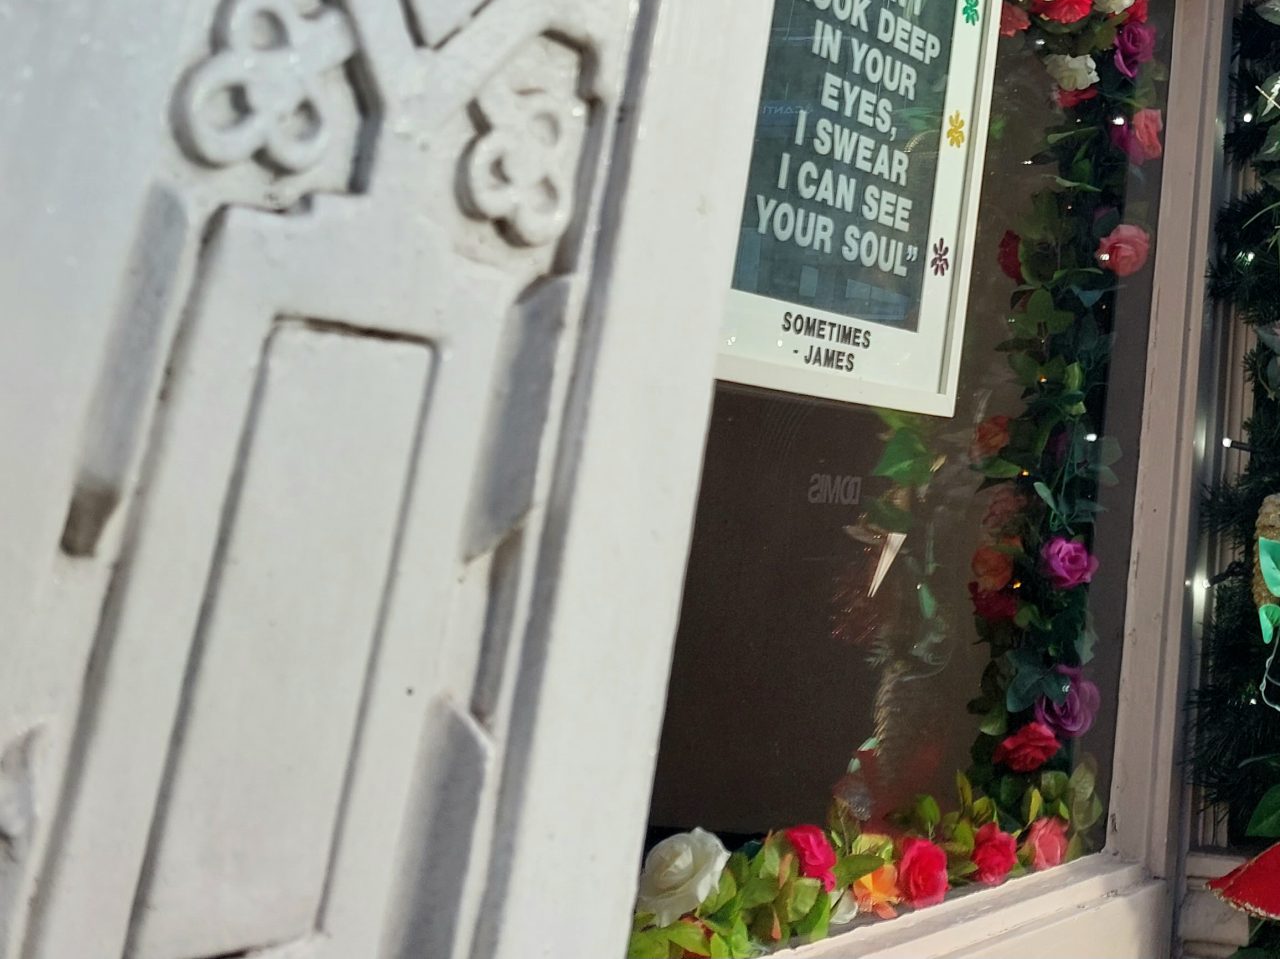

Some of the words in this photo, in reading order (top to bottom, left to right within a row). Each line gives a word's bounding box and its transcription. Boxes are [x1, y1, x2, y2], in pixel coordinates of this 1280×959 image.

[811, 18, 843, 64] IN
[851, 37, 918, 101] YOUR
[876, 7, 941, 65] DEEP
[820, 71, 898, 142] EYES,
[794, 109, 808, 146] I
[812, 117, 910, 187] SWEAR
[755, 193, 835, 254] YOUR
[777, 151, 791, 190] I
[797, 160, 857, 213] CAN
[861, 184, 914, 233] SEE
[781, 310, 872, 350] SOMETIMES
[803, 344, 856, 373] JAMES
